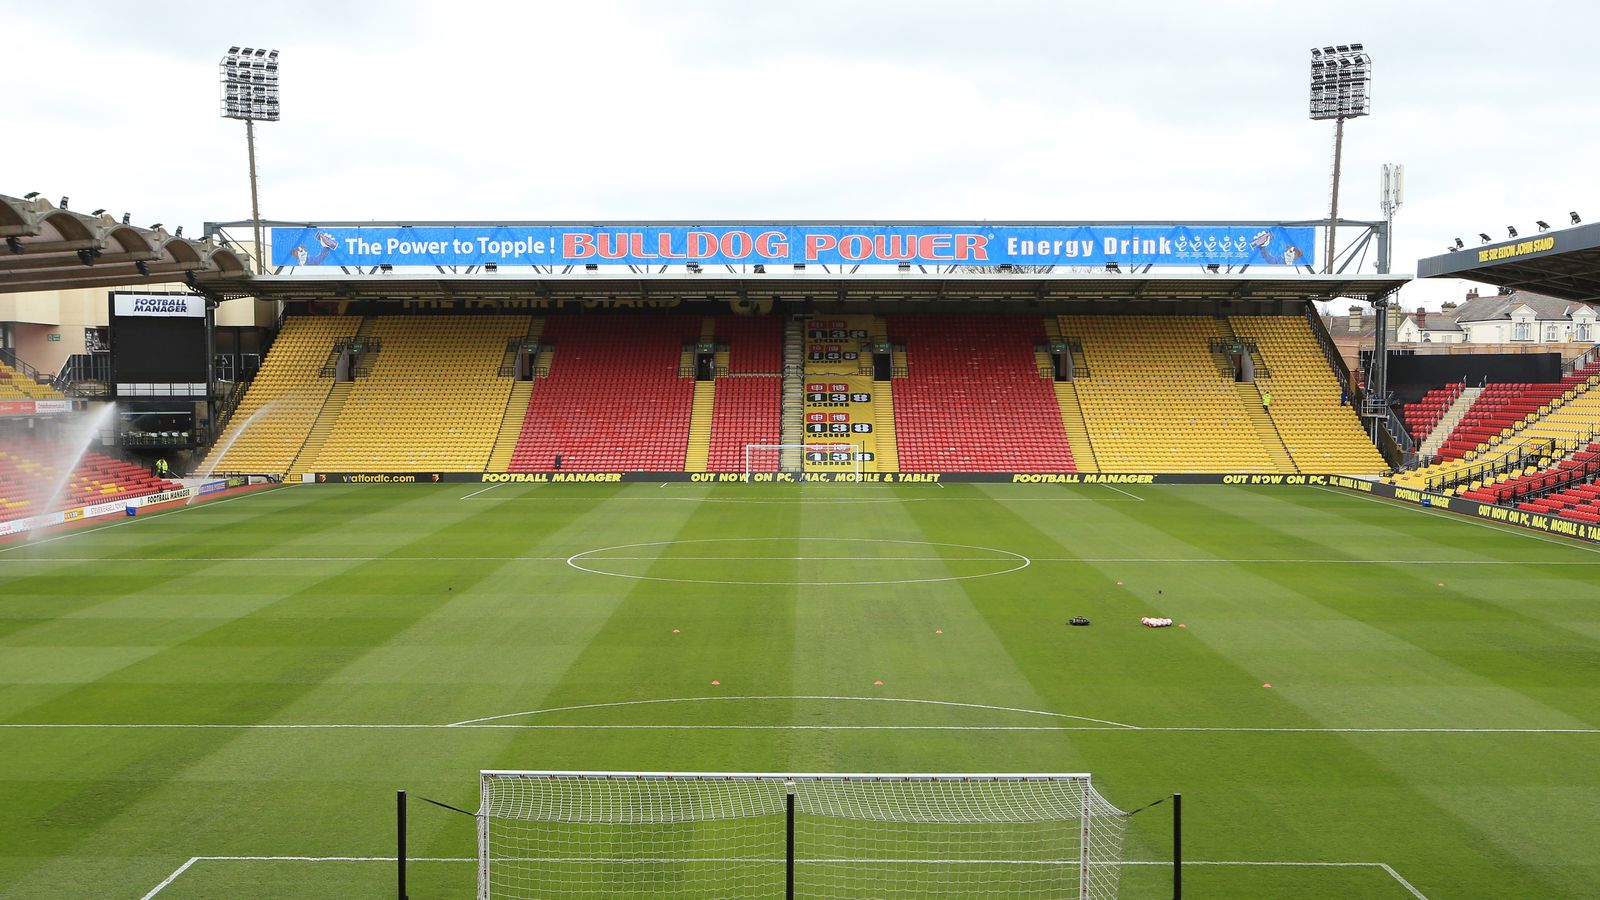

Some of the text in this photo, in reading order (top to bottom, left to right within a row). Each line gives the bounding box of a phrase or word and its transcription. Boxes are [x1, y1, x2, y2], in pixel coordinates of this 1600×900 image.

[346, 237, 382, 255] The
[388, 237, 447, 255] Power
[452, 238, 473, 255] to
[562, 231, 789, 260] BULLDOG
[1007, 237, 1094, 257] Energy
[1104, 237, 1172, 255] Drink
[809, 393, 869, 402] 138
[809, 423, 870, 432] 138
[482, 473, 622, 482] FOOTBALL MANAGER
[691, 473, 716, 482] OUT
[719, 473, 750, 482] NOW
[754, 473, 773, 482] ON
[777, 473, 795, 483] PC,
[835, 473, 880, 482] MOBILE
[884, 473, 894, 482] &
[898, 473, 940, 482] TABLET
[1013, 474, 1154, 483] FOOTBALL MANAGER
[1223, 475, 1248, 484] OUT
[1251, 475, 1284, 484] NOW
[1286, 475, 1307, 484] ON
[1309, 475, 1328, 486] PC,
[147, 489, 190, 504] FOOTBALL MANAGER
[1395, 488, 1420, 502] FOOTBALL
[1478, 504, 1491, 516] OUT
[1491, 507, 1508, 520] NOW
[1509, 511, 1519, 523] ON
[1520, 513, 1530, 527] PC,
[1532, 515, 1548, 531] MAC,
[1551, 519, 1577, 535] MOBILE
[1578, 525, 1585, 537] &
